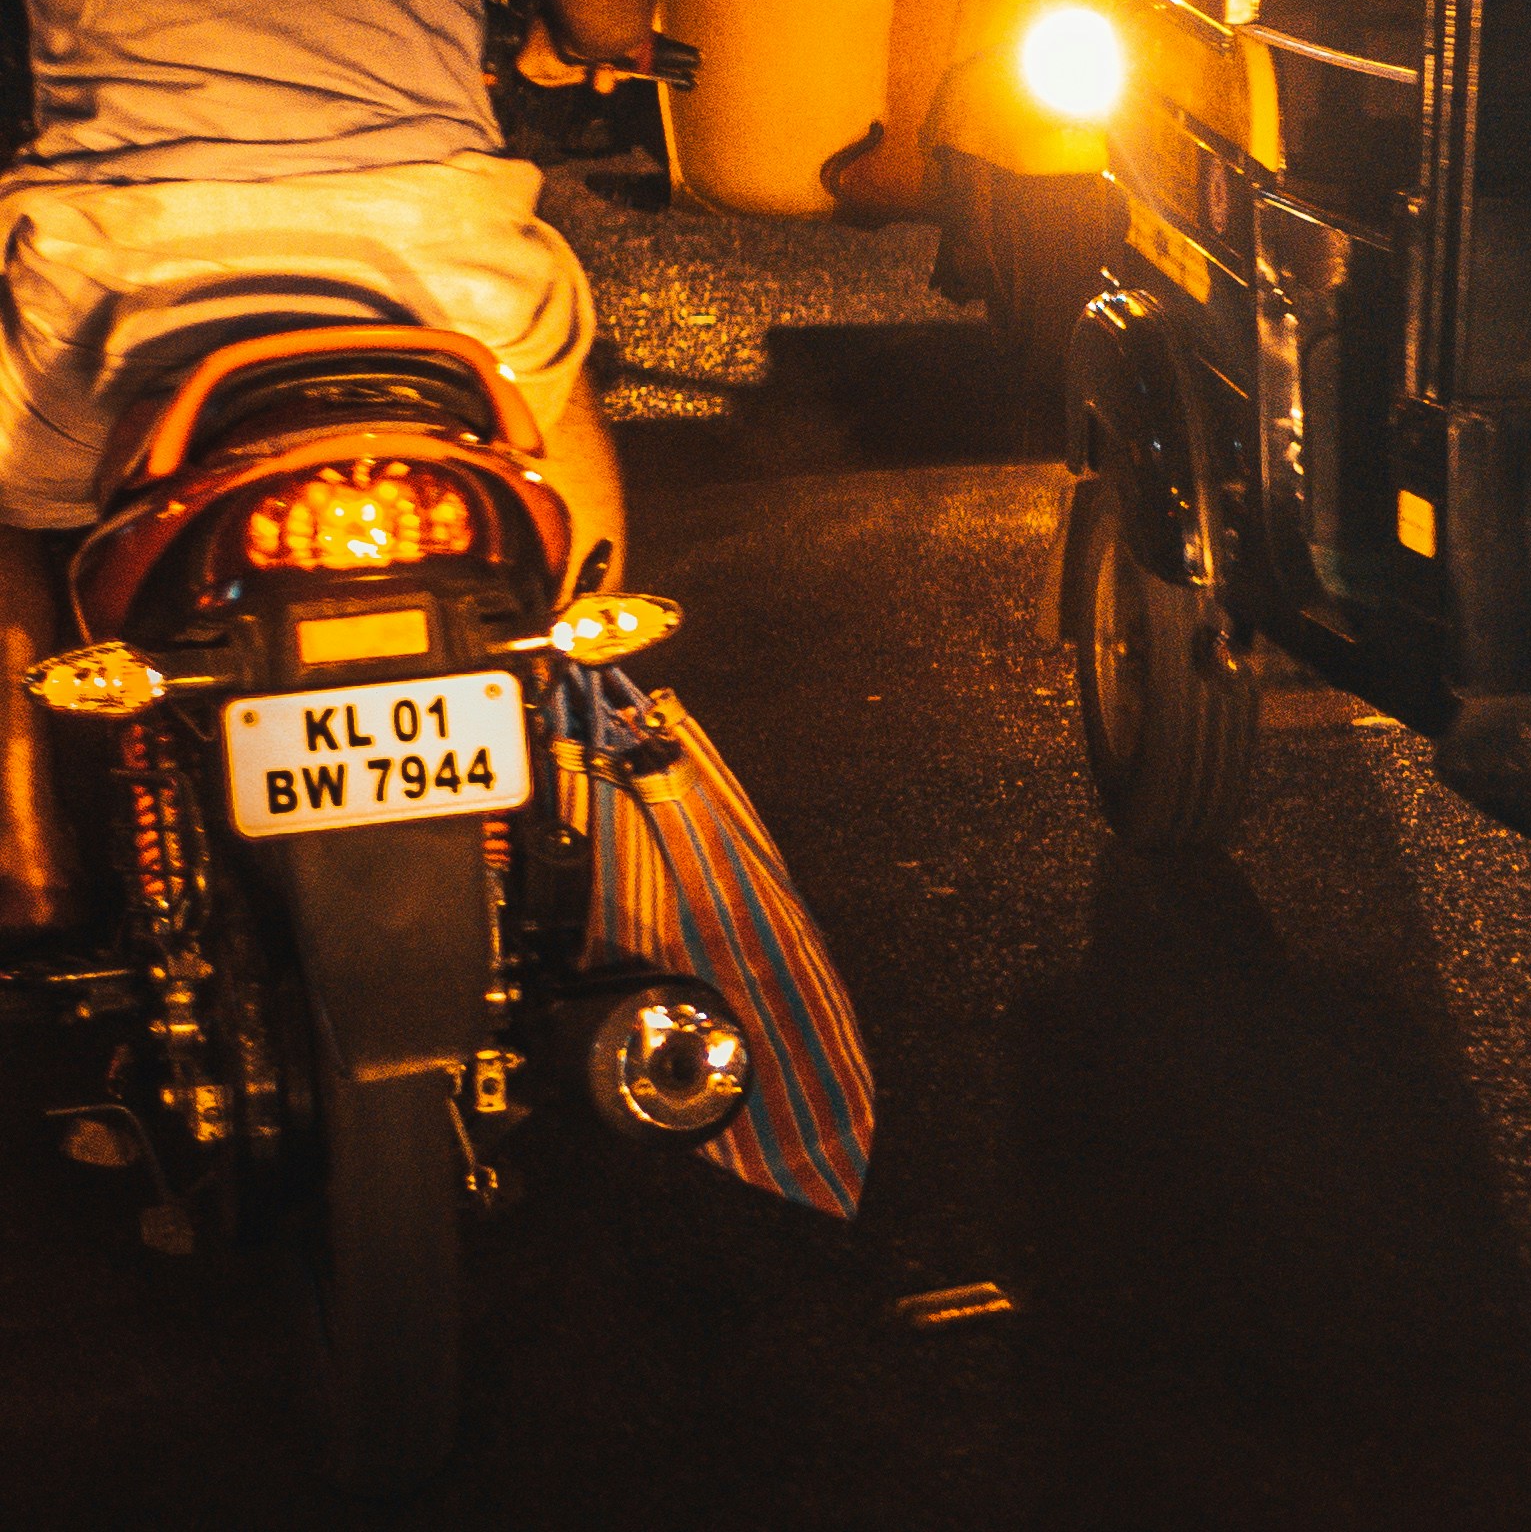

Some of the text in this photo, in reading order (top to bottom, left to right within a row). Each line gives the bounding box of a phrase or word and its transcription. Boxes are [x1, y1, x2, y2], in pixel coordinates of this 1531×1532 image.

[304, 696, 447, 753] KL 01
[266, 747, 495, 815] BW 7944
